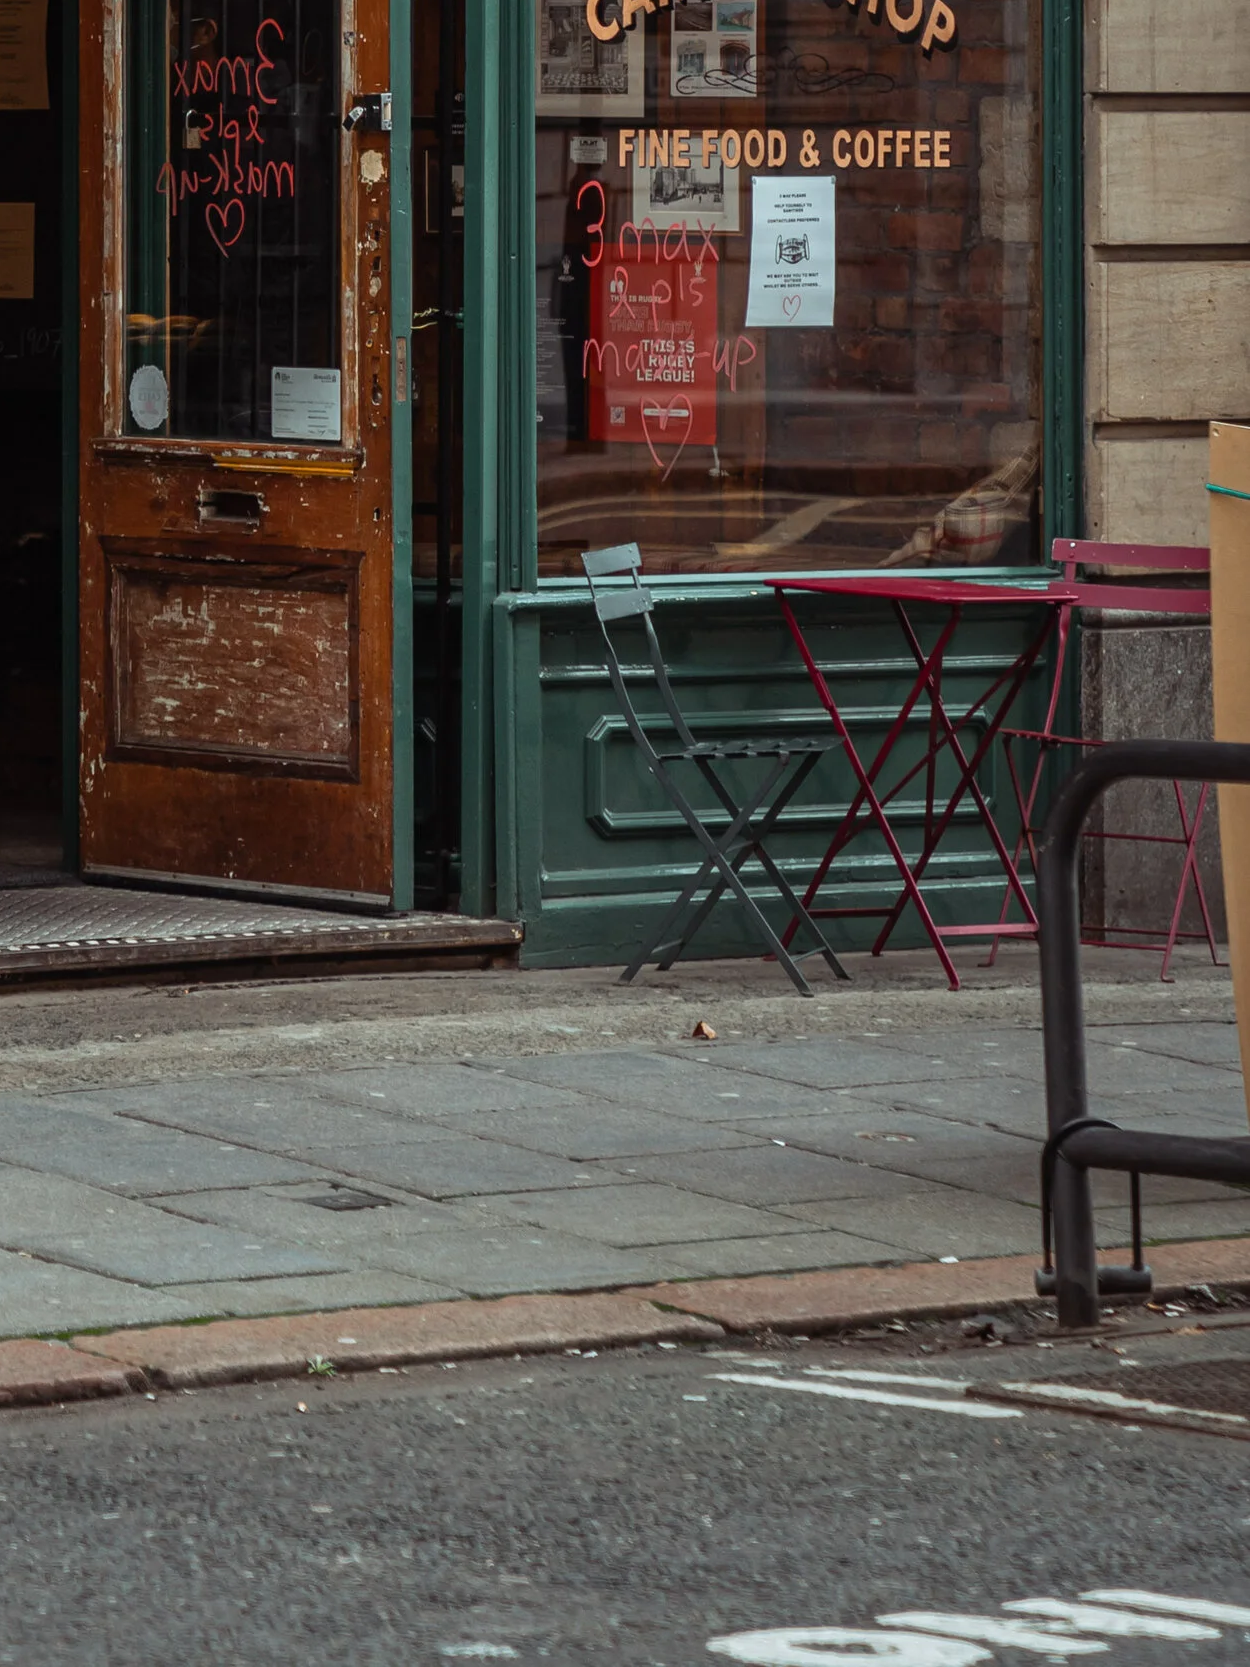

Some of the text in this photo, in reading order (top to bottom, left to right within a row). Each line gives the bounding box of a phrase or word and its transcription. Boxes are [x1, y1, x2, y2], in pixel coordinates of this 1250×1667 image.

[618, 129, 691, 168] FINE
[702, 129, 787, 168] FOOD
[799, 130, 821, 168] &
[833, 130, 950, 168] COFFEE
[577, 180, 720, 268] 3 max
[642, 339, 695, 354] THIS IS
[637, 368, 695, 383] LEAGUE!
